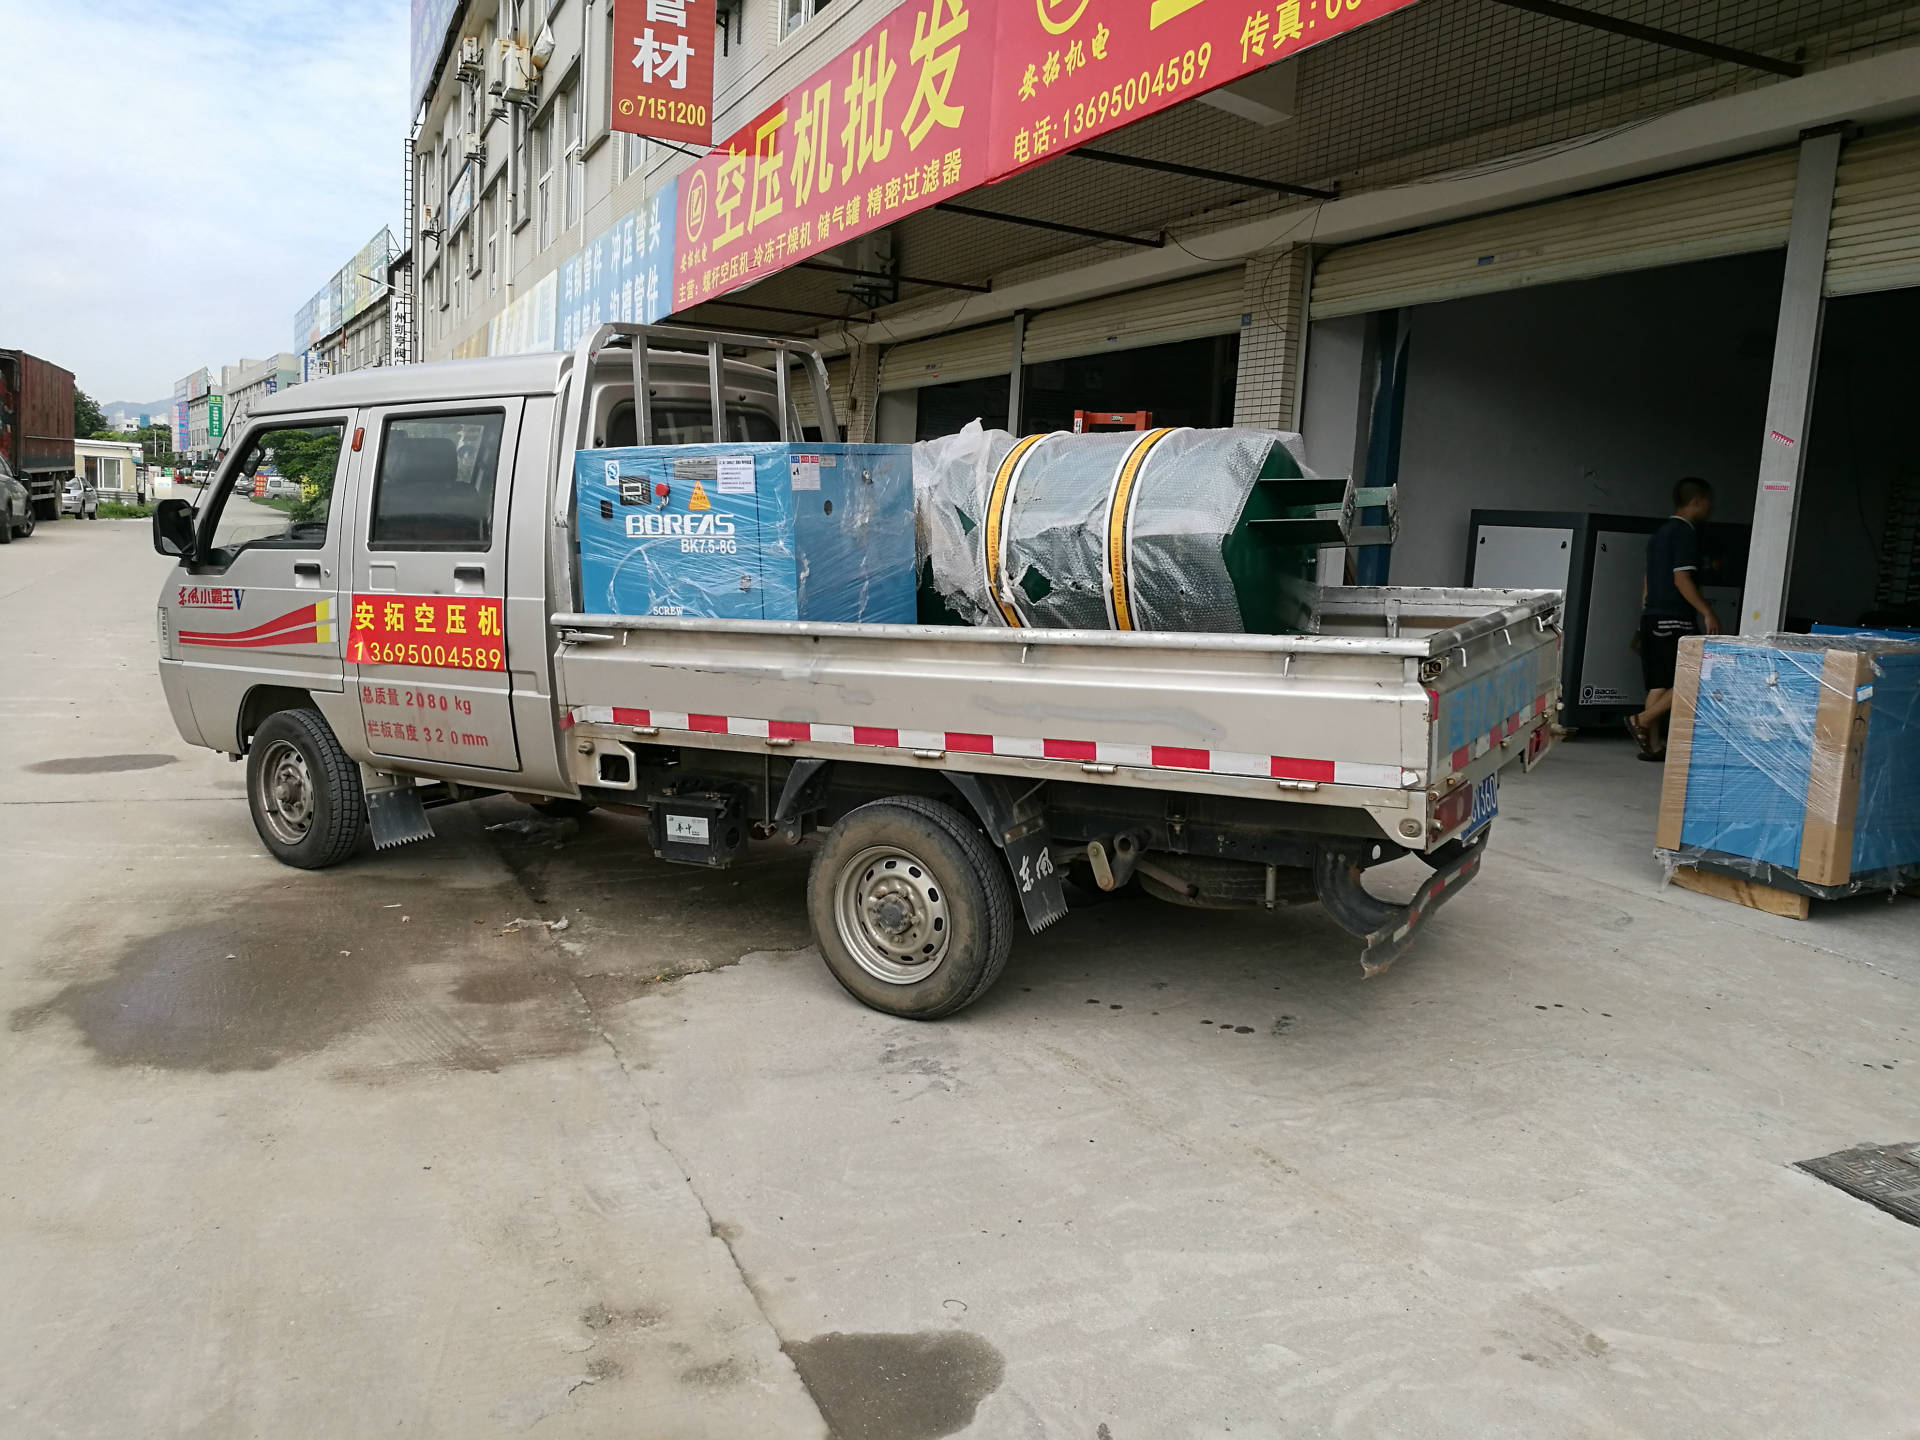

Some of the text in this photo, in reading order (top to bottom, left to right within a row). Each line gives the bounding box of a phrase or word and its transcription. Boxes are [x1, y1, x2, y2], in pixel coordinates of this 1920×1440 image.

[1018, 22, 1110, 102] 安拓机电
[637, 95, 706, 127] 7151200
[711, 0, 970, 251] 空压机批发
[752, 221, 812, 268] 冷冻干燥机
[817, 194, 862, 242] 储气罐
[866, 147, 963, 219] 精密过滤器
[625, 513, 736, 536] BOREAS
[681, 538, 737, 555] BK7.5-8G
[355, 600, 502, 637] 安拓空压机
[652, 606, 684, 616] SCREW
[353, 641, 502, 670] 13695004589
[362, 686, 472, 716] 总质量 2080 kg
[367, 720, 419, 742] 栏板高度
[1019, 846, 1054, 893] 东风
